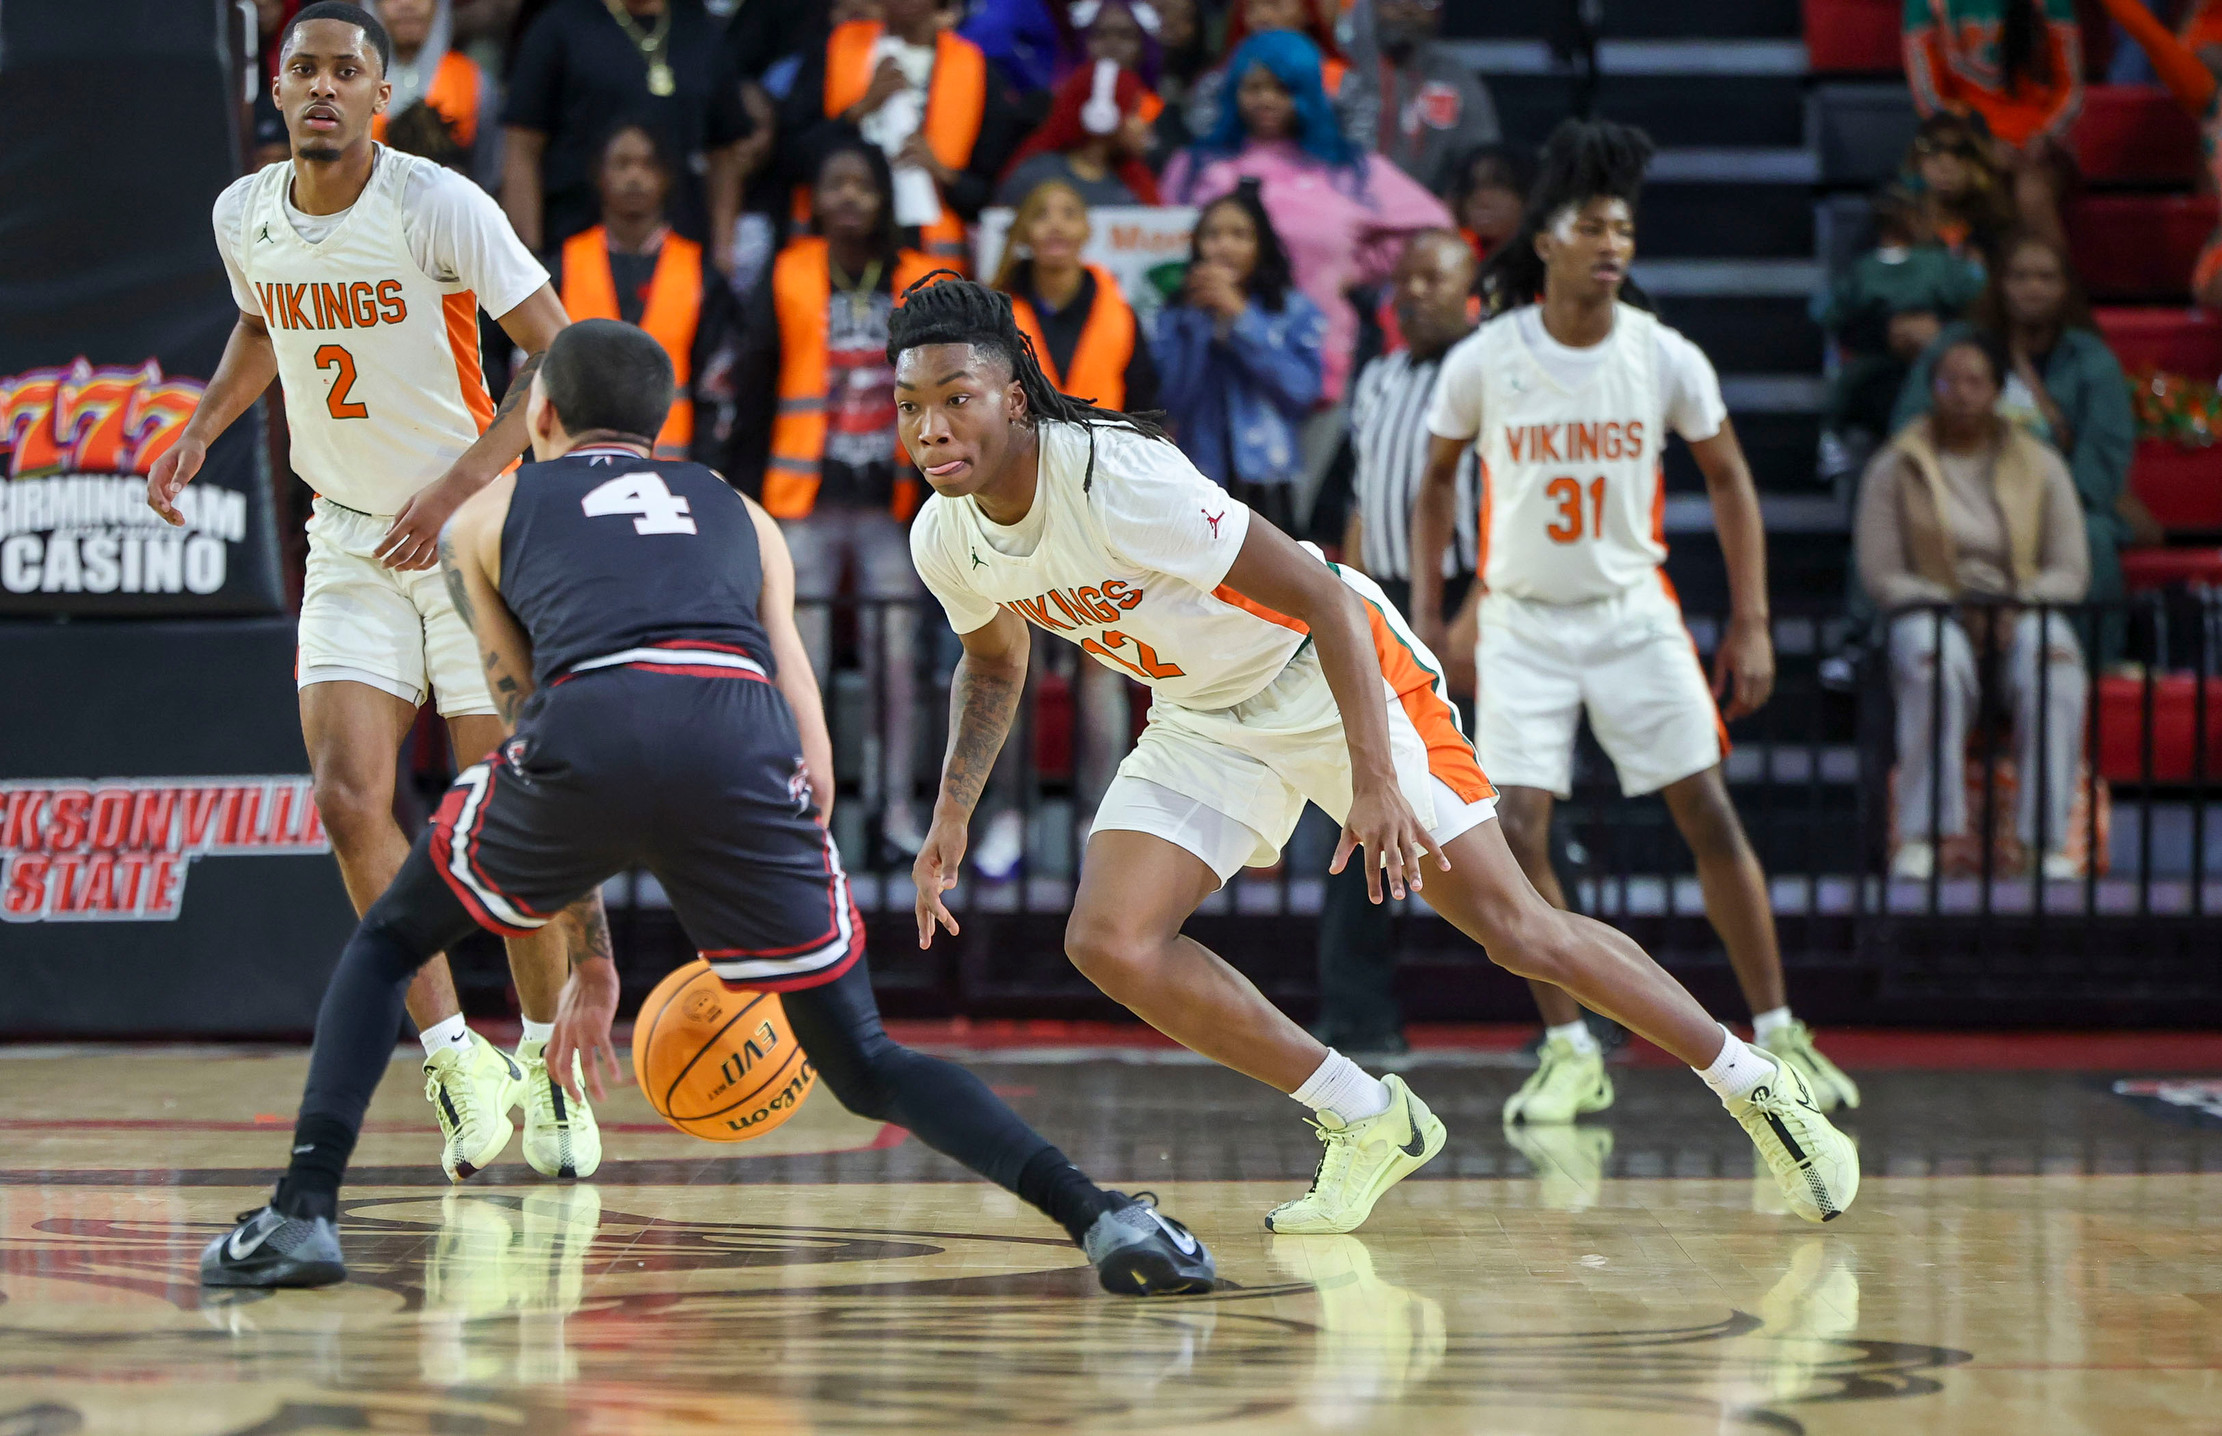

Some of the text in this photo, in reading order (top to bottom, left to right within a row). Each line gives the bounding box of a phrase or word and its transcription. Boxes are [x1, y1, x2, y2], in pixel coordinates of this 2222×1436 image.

[255, 278, 408, 330] VIKINGS
[313, 343, 370, 420] 2
[1505, 420, 1644, 463] VIKINGS
[0, 474, 247, 542] IRMINGAM
[580, 471, 698, 536] 4
[1545, 475, 1607, 544] 31
[1, 533, 227, 595] CASINO
[1080, 629, 1187, 680] 12
[2, 850, 182, 914] STATE
[720, 1018, 779, 1087] EVO
